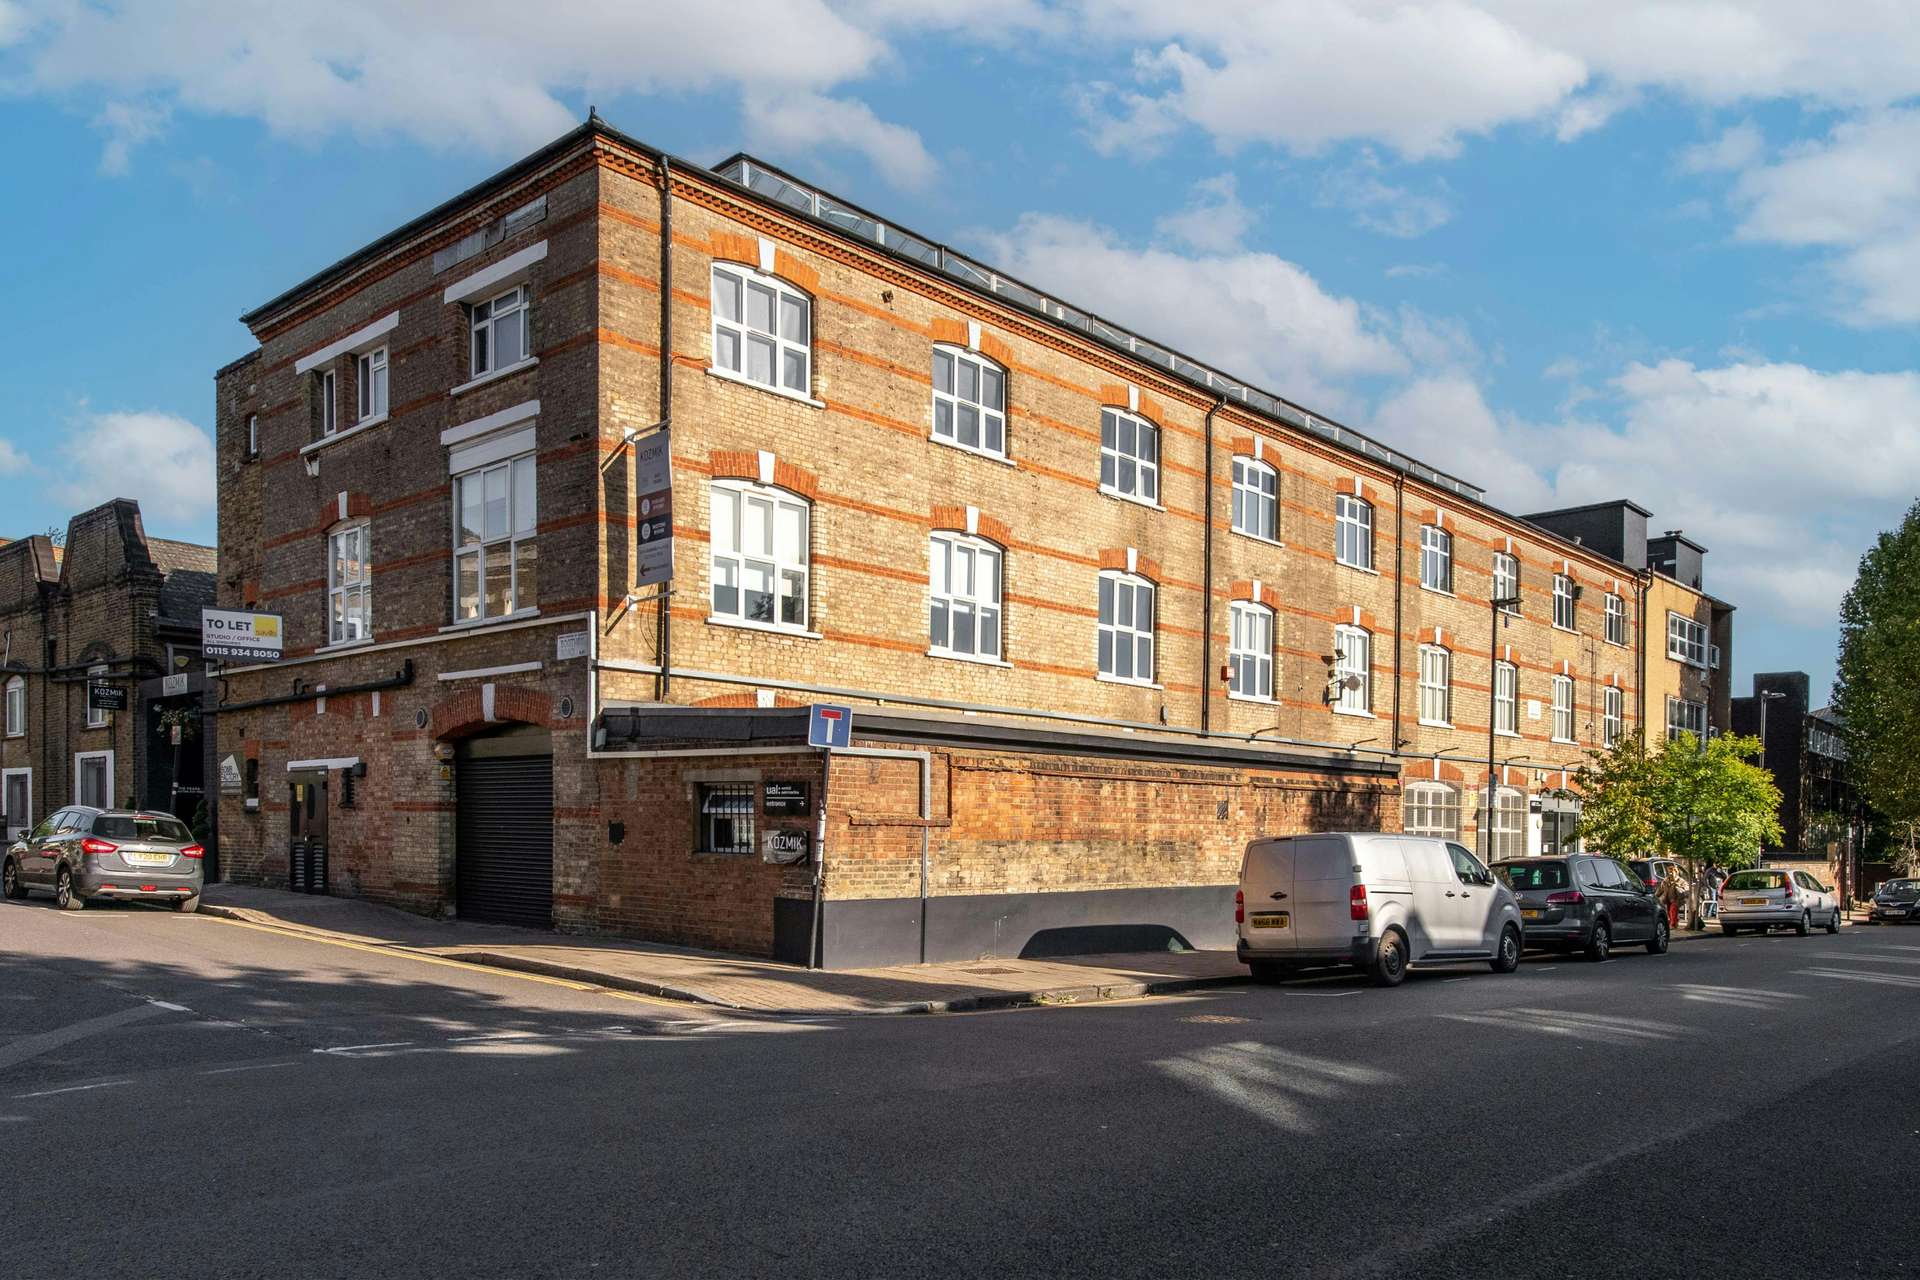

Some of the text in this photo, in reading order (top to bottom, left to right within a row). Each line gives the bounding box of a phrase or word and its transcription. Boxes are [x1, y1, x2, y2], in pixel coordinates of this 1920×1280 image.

[206, 618, 252, 631] TO LET
[206, 646, 280, 659] 0115 934 8050
[94, 687, 124, 697] KOZMIK
[767, 836, 803, 850] KOZMIK
